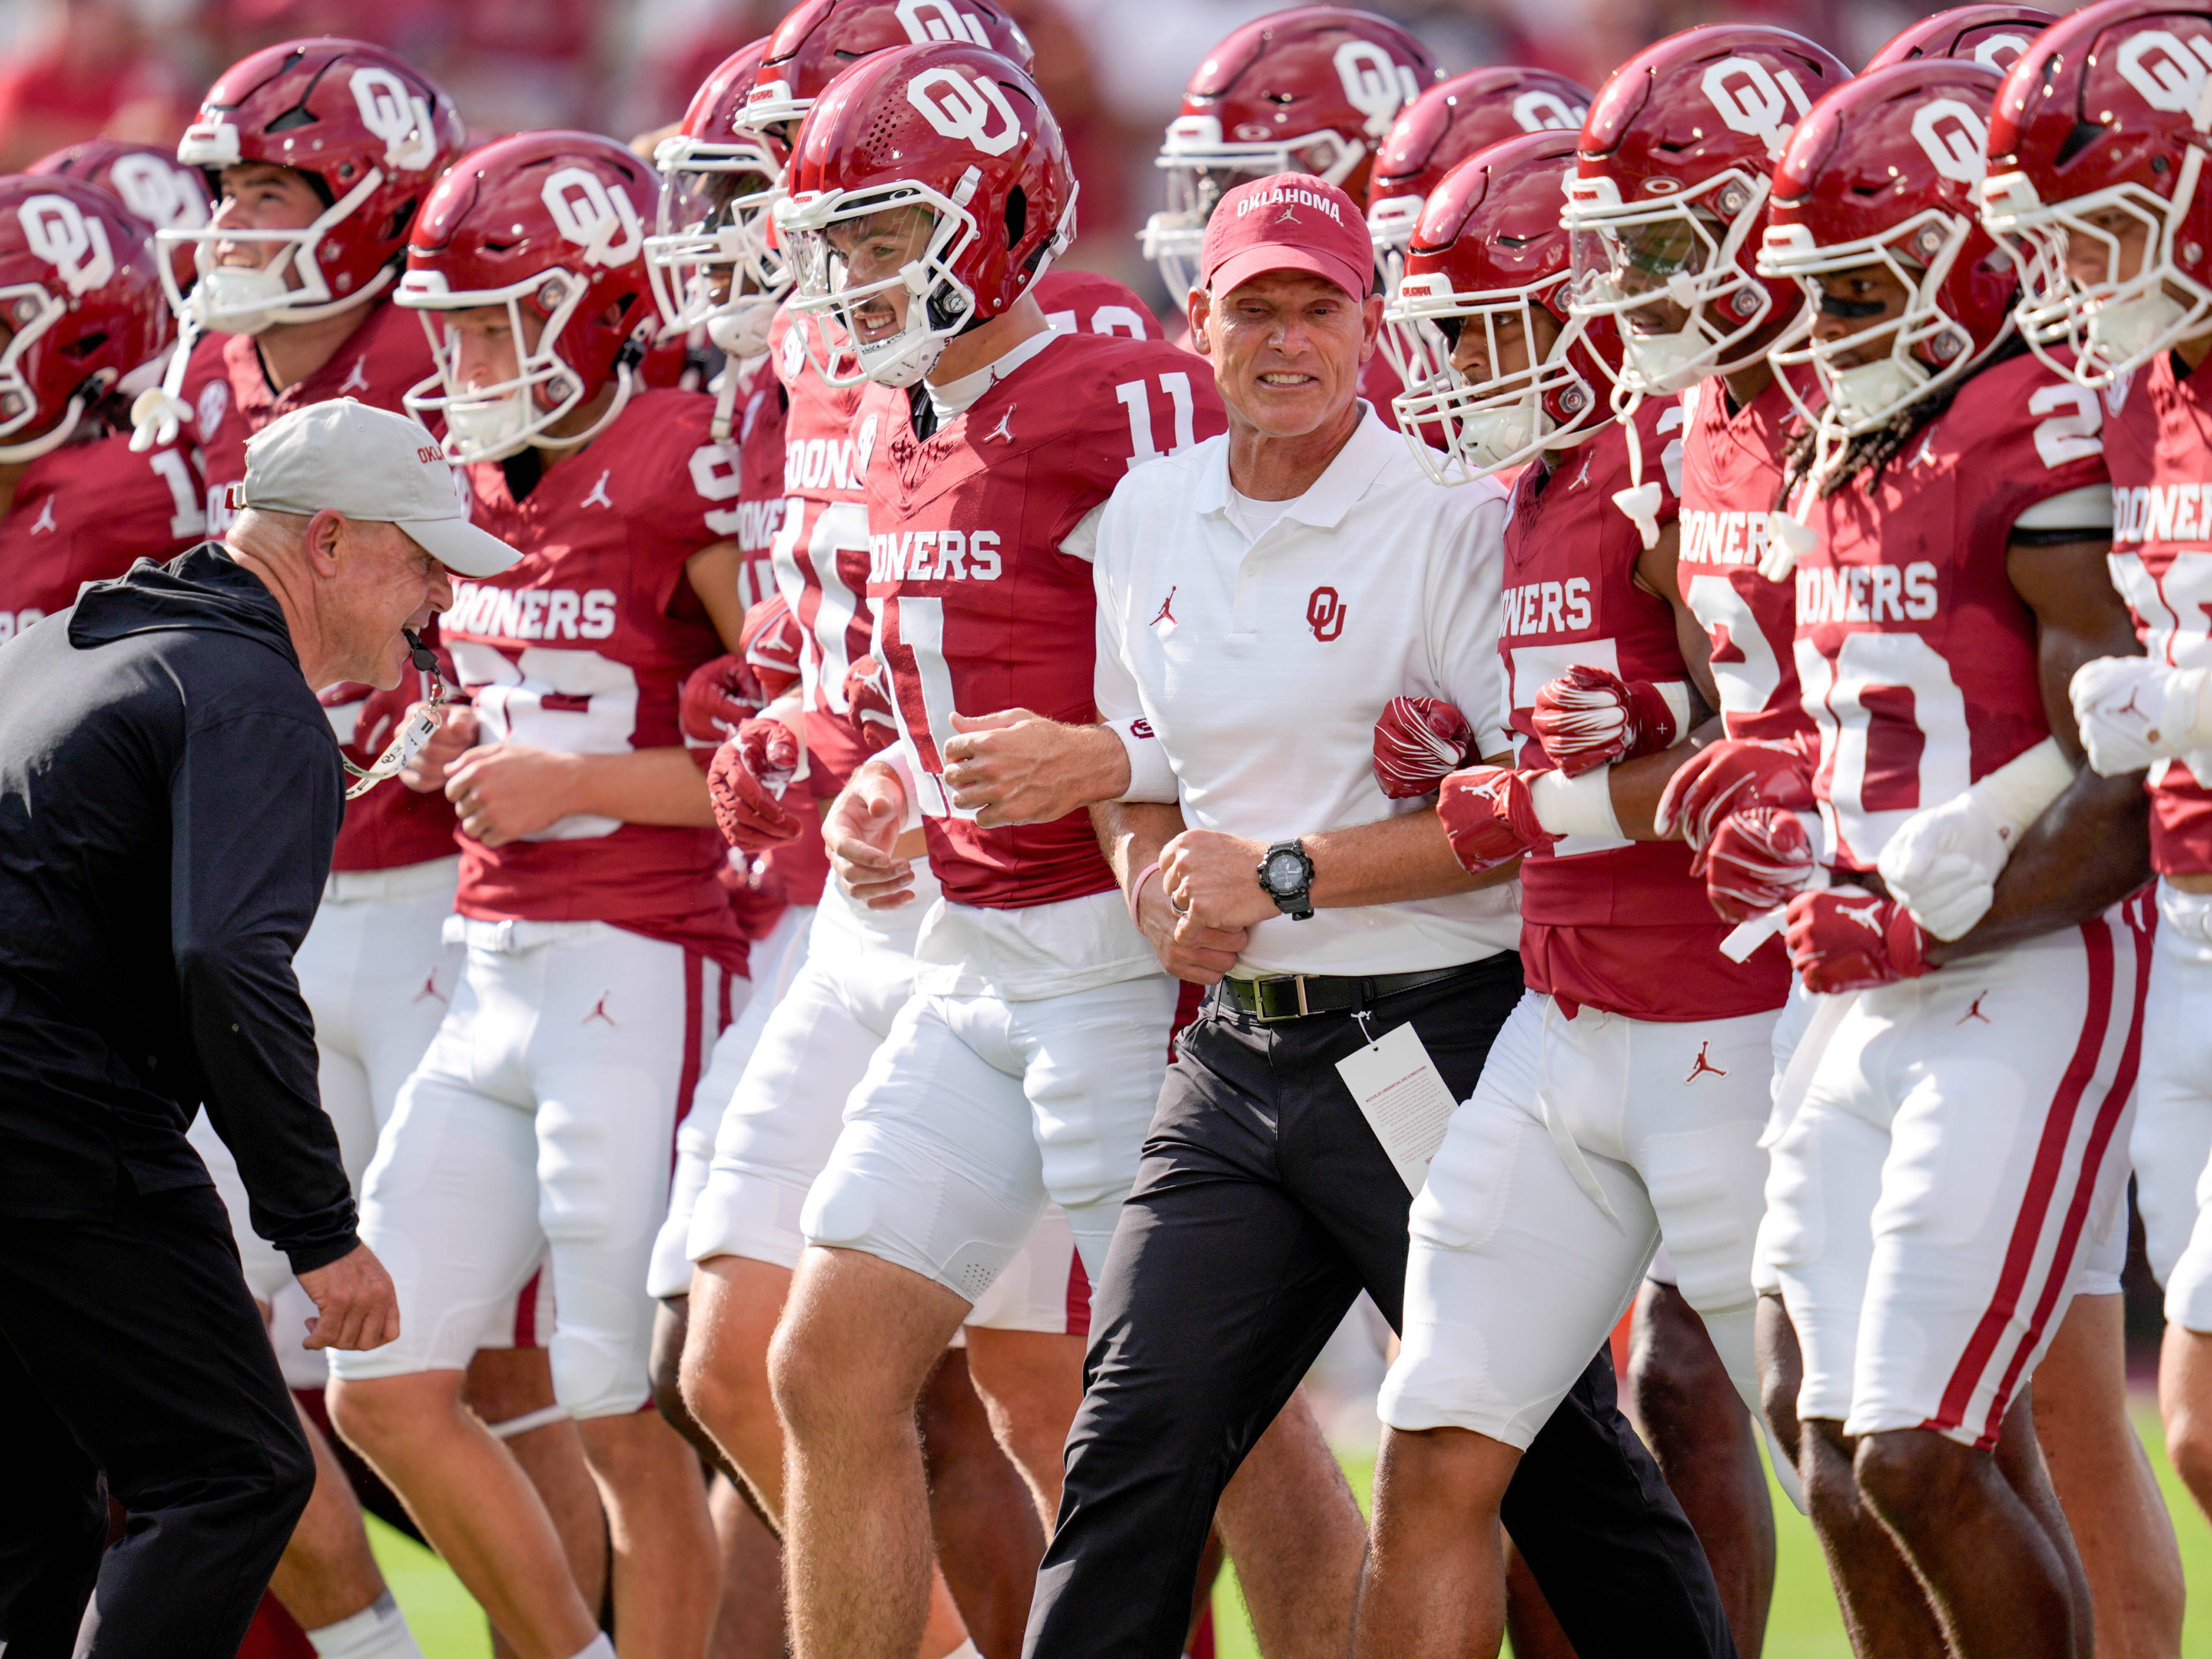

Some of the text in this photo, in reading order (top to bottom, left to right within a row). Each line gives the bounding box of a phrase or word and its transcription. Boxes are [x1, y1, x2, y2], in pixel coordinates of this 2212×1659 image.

[349, 67, 438, 171] OU
[907, 67, 1021, 157] OU
[110, 152, 209, 230] OU
[541, 167, 643, 268] OU
[1237, 188, 1341, 224] OKLAHOMA
[17, 194, 115, 297] OU
[1116, 372, 1196, 472] 11
[1306, 586, 1347, 642] OU
